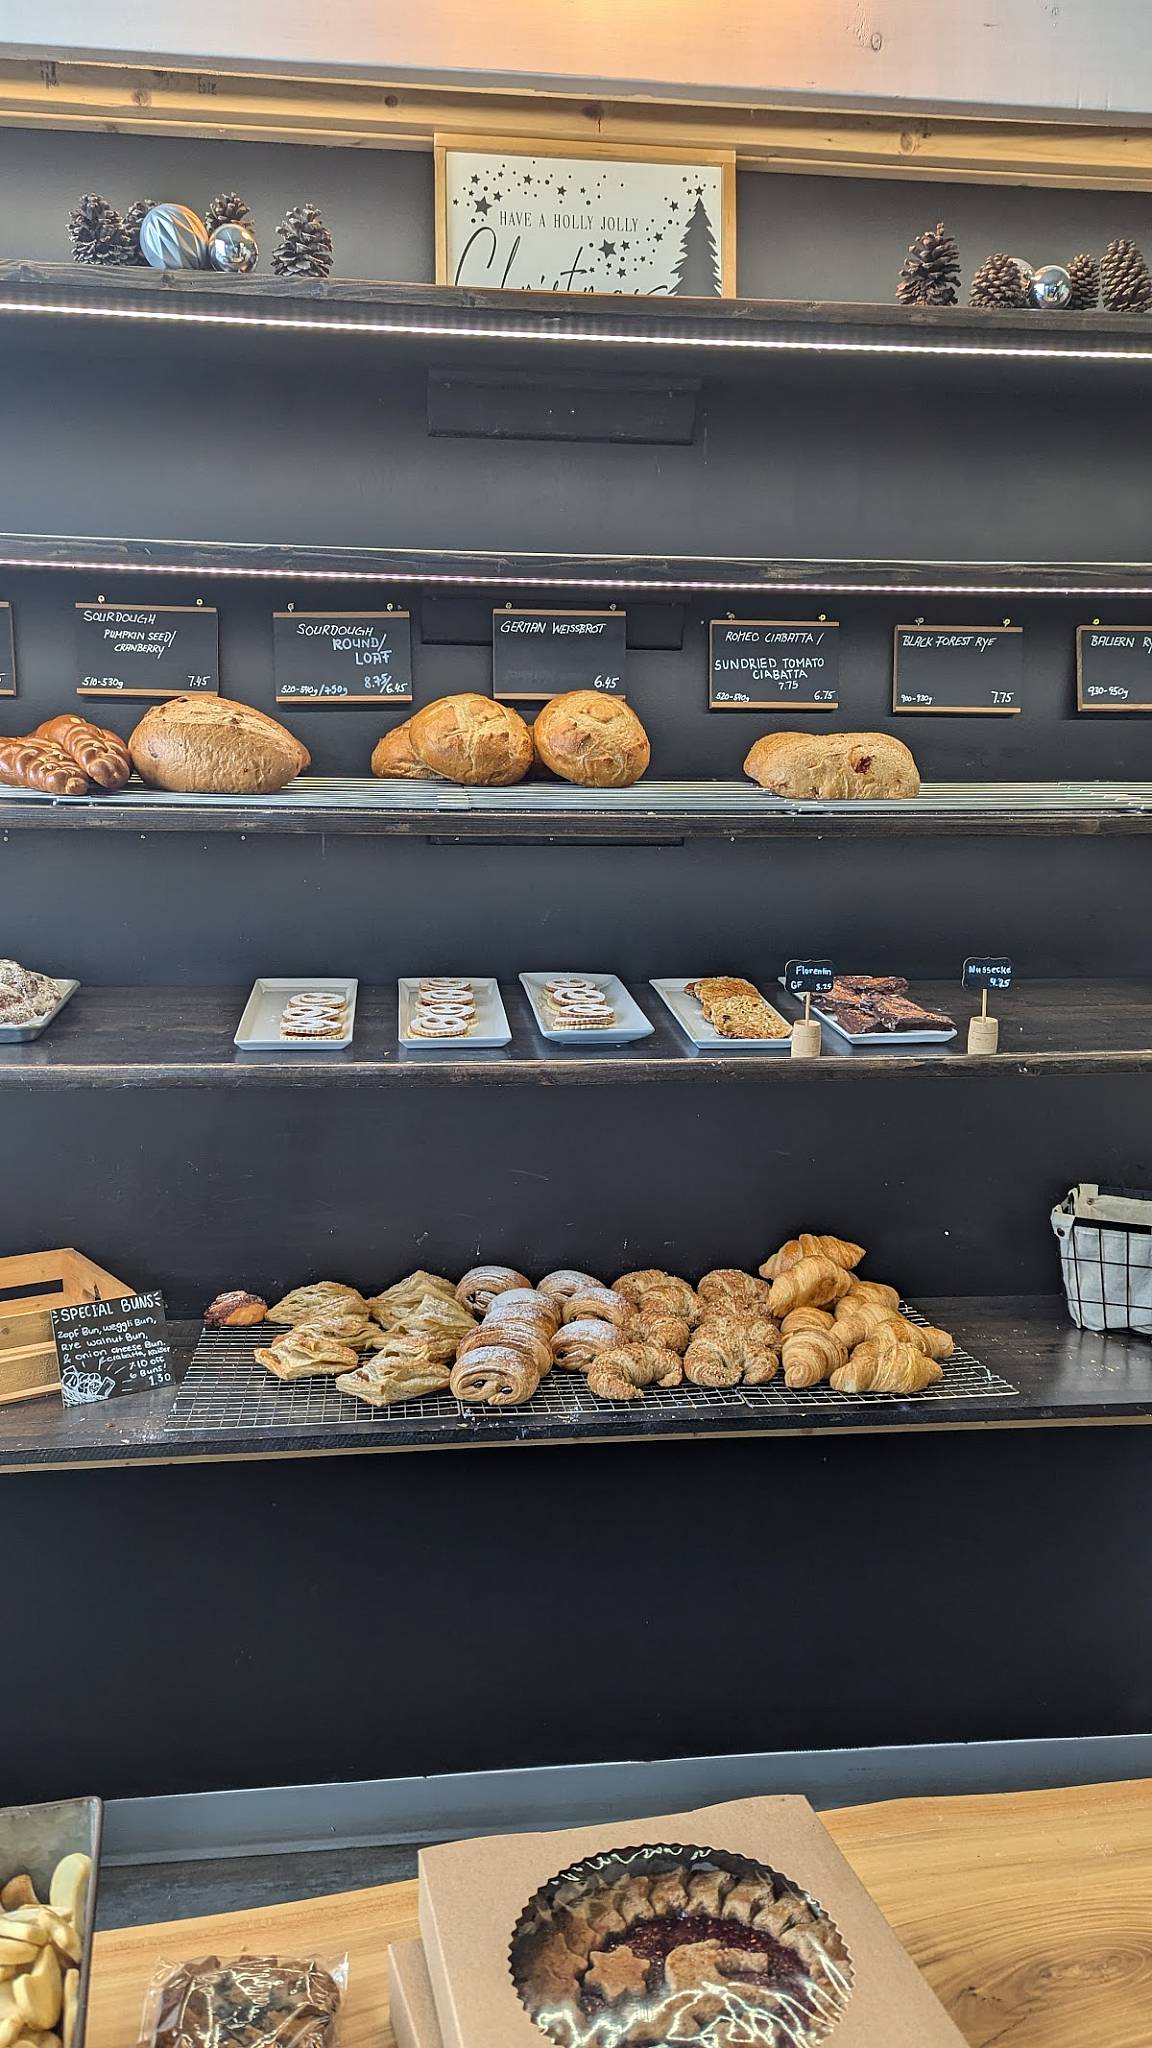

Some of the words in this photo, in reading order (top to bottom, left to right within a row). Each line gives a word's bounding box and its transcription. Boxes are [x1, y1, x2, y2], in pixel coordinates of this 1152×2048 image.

[499, 211, 533, 227] HAVE
[538, 213, 546, 228] A
[553, 213, 594, 230] HOLLY
[600, 216, 639, 233] JOLLY
[83, 610, 156, 624] SOURDOUGH
[296, 623, 374, 637] SOURDOUGH
[500, 620, 547, 634] GERMAN
[552, 621, 607, 635] WEISSBROT
[103, 629, 145, 641] PUMPKIN
[147, 630, 177, 648] SEED/
[332, 633, 387, 652] ROUND/
[725, 630, 760, 643] ROMEO
[764, 632, 814, 644] CIABATTA
[902, 634, 934, 648] BLACK
[935, 635, 975, 648] FOREST
[1090, 634, 1136, 648] BAUERN
[114, 643, 165, 660] CRANBERRY
[355, 649, 393, 666] LOAF
[714, 657, 777, 671] SUNDRIED
[782, 657, 825, 669] TOMATO
[187, 675, 211, 687] 7.45
[752, 668, 809, 680] CIABATTA
[593, 674, 620, 689] 6.45
[778, 680, 799, 691] 7.75
[813, 690, 836, 700] 6.75
[990, 690, 1015, 704] 7.75
[795, 965, 832, 976] Florentin
[968, 964, 1012, 975] Nussecke
[790, 980, 804, 990] GF
[989, 977, 1011, 988] 4.25
[60, 1302, 114, 1322] SPECIAL
[120, 1294, 154, 1313] BUNS
[81, 1326, 102, 1336] Bun,
[102, 1319, 133, 1333] weggli
[134, 1316, 157, 1327] Bun,
[86, 1334, 123, 1347] walnut
[125, 1331, 148, 1342] Bun,
[75, 1348, 108, 1361] onion
[110, 1345, 143, 1355] cheese
[148, 1372, 171, 1387] 1.30
